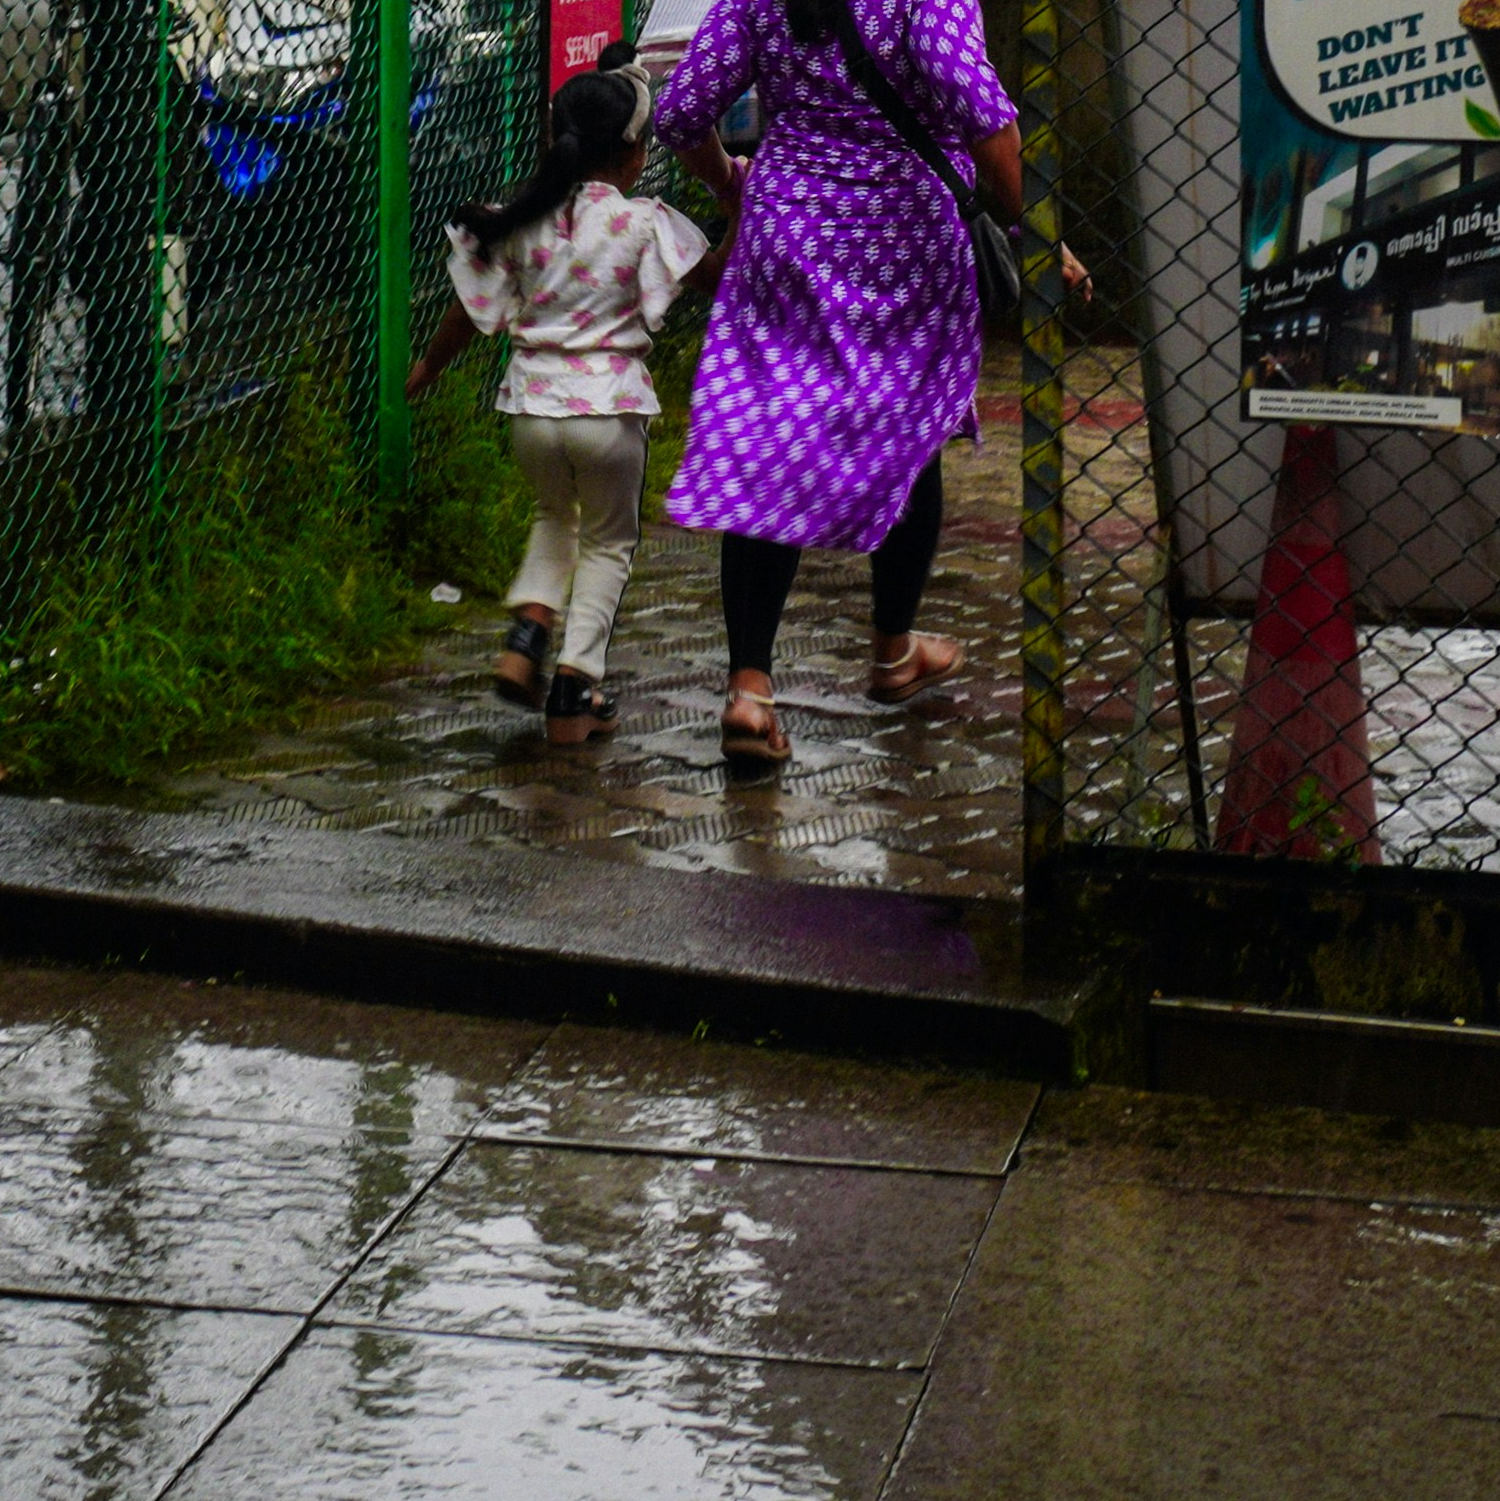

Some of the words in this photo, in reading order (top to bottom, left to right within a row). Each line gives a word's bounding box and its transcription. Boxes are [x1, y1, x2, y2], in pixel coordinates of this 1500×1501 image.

[1317, 12, 1424, 62] DON'T
[1317, 45, 1427, 95] LEAVE
[1434, 33, 1471, 64] IT
[1327, 62, 1487, 124] WAITING
